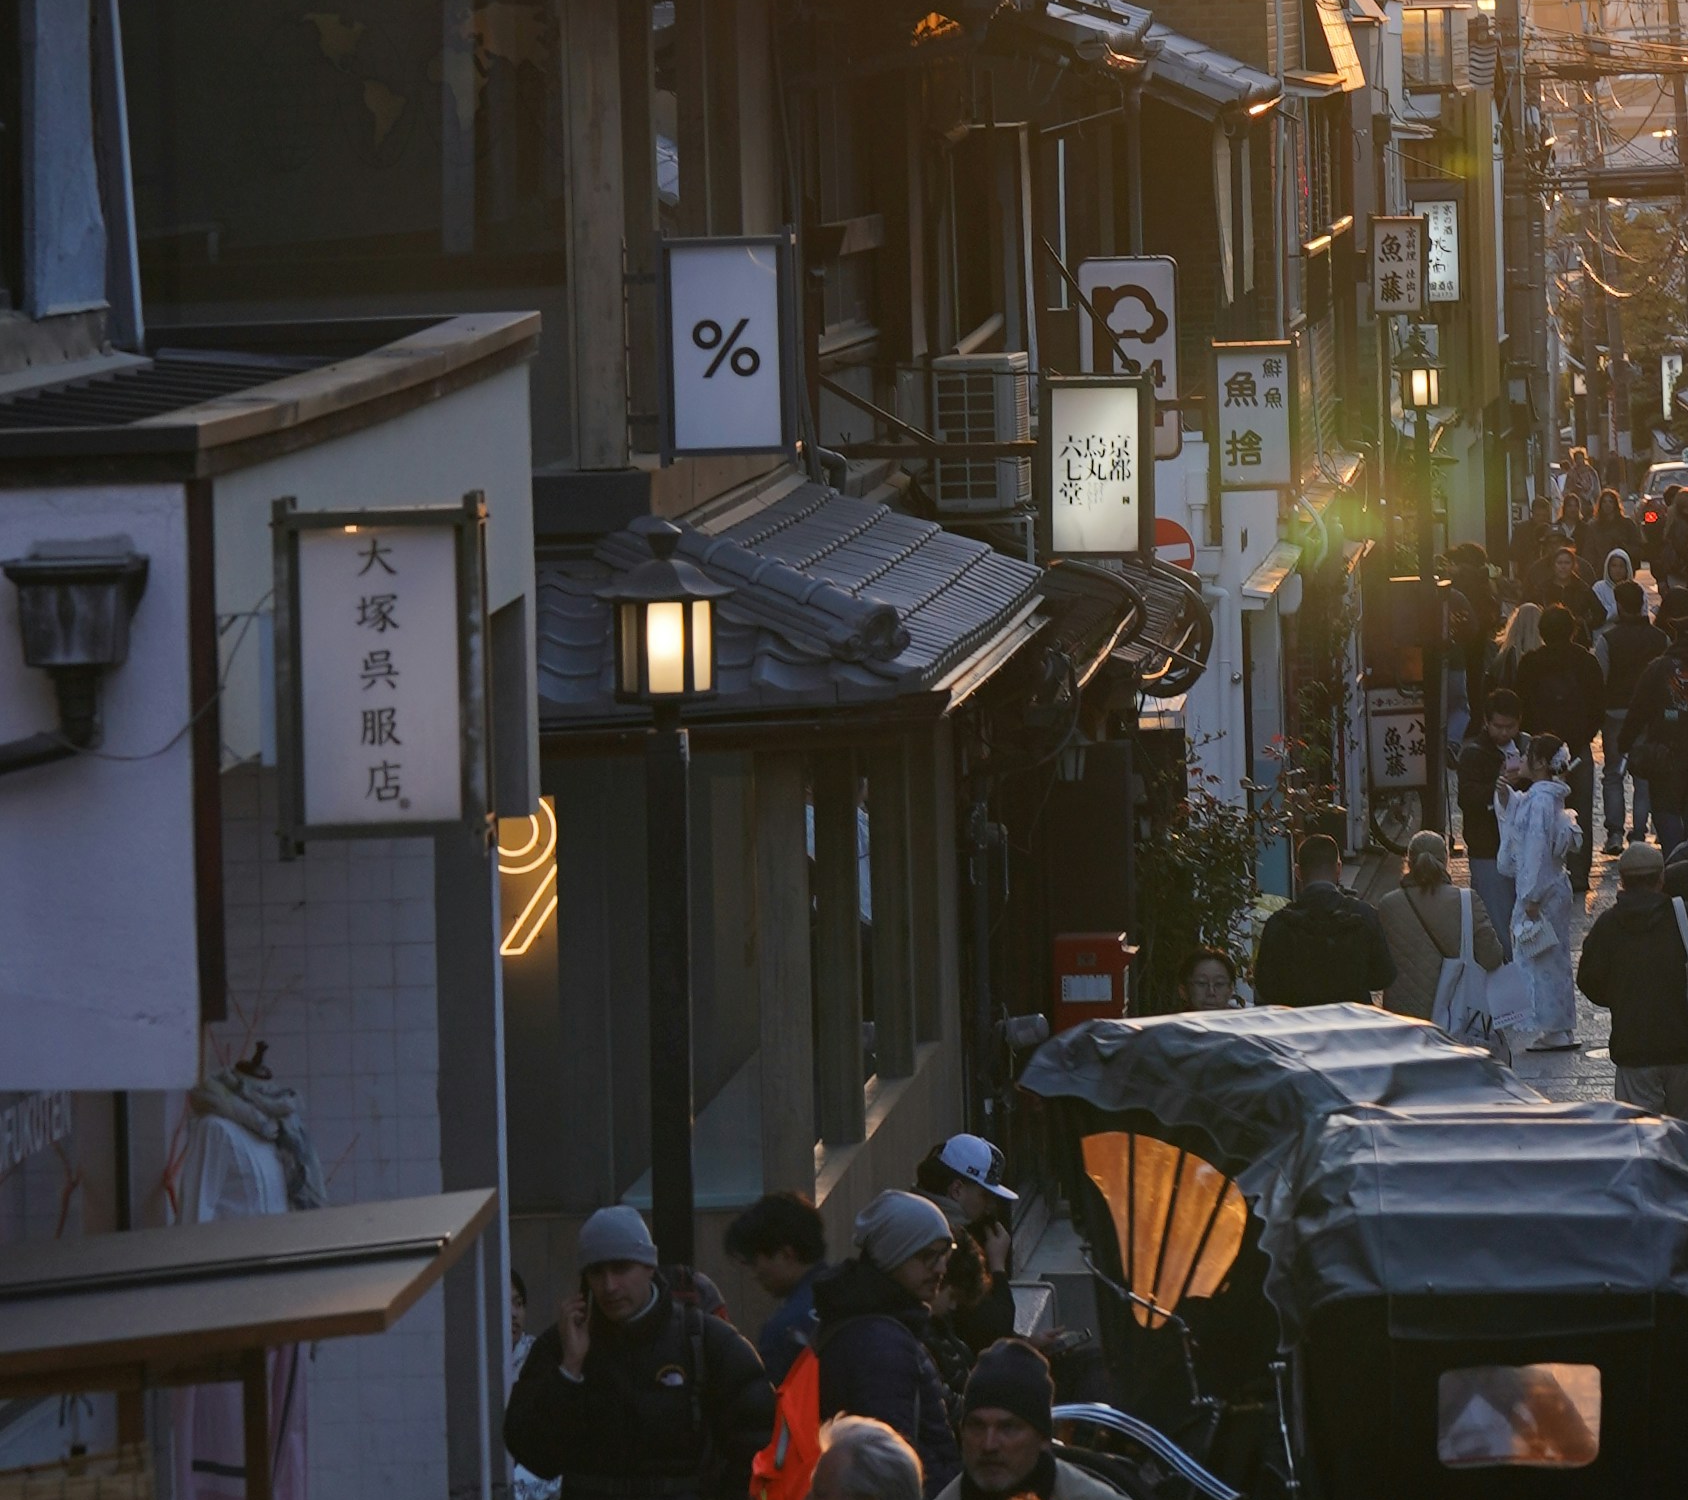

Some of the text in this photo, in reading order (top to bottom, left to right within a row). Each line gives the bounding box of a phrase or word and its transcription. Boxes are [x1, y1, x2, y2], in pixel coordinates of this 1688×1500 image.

[1378, 232, 1405, 303] 魚藤
[1262, 357, 1284, 409] 鮮魚
[1224, 371, 1263, 467] 魚捨
[355, 538, 402, 801] 大塚呉服店
[1382, 726, 1408, 778] 魚藤
